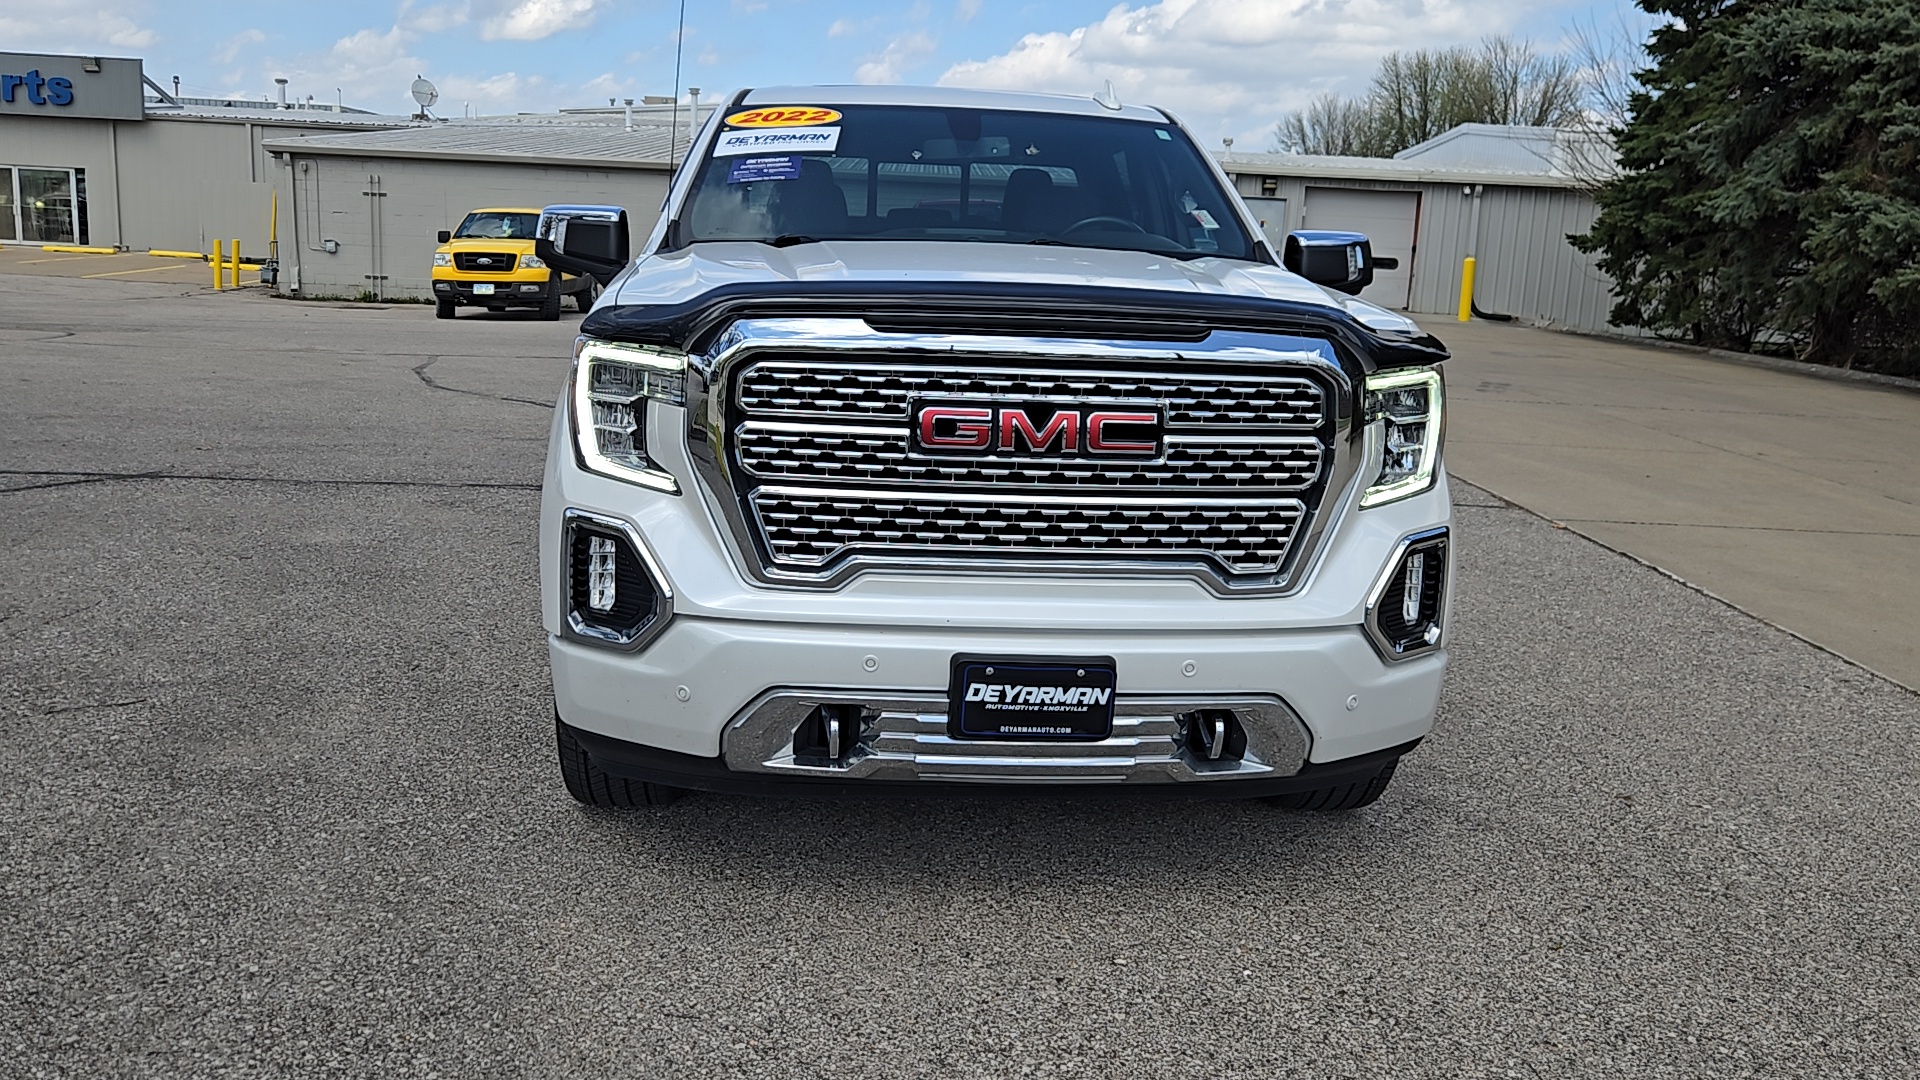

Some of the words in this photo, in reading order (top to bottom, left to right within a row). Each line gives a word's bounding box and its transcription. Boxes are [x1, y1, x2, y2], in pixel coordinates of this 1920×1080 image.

[1, 69, 74, 106] rts
[736, 110, 832, 125] 2022
[725, 133, 832, 146] DEYARMAN
[918, 406, 1158, 455] GMC
[964, 682, 1112, 705] DEYARMAN
[999, 725, 1072, 734] DEYARMANAUTO.COM
